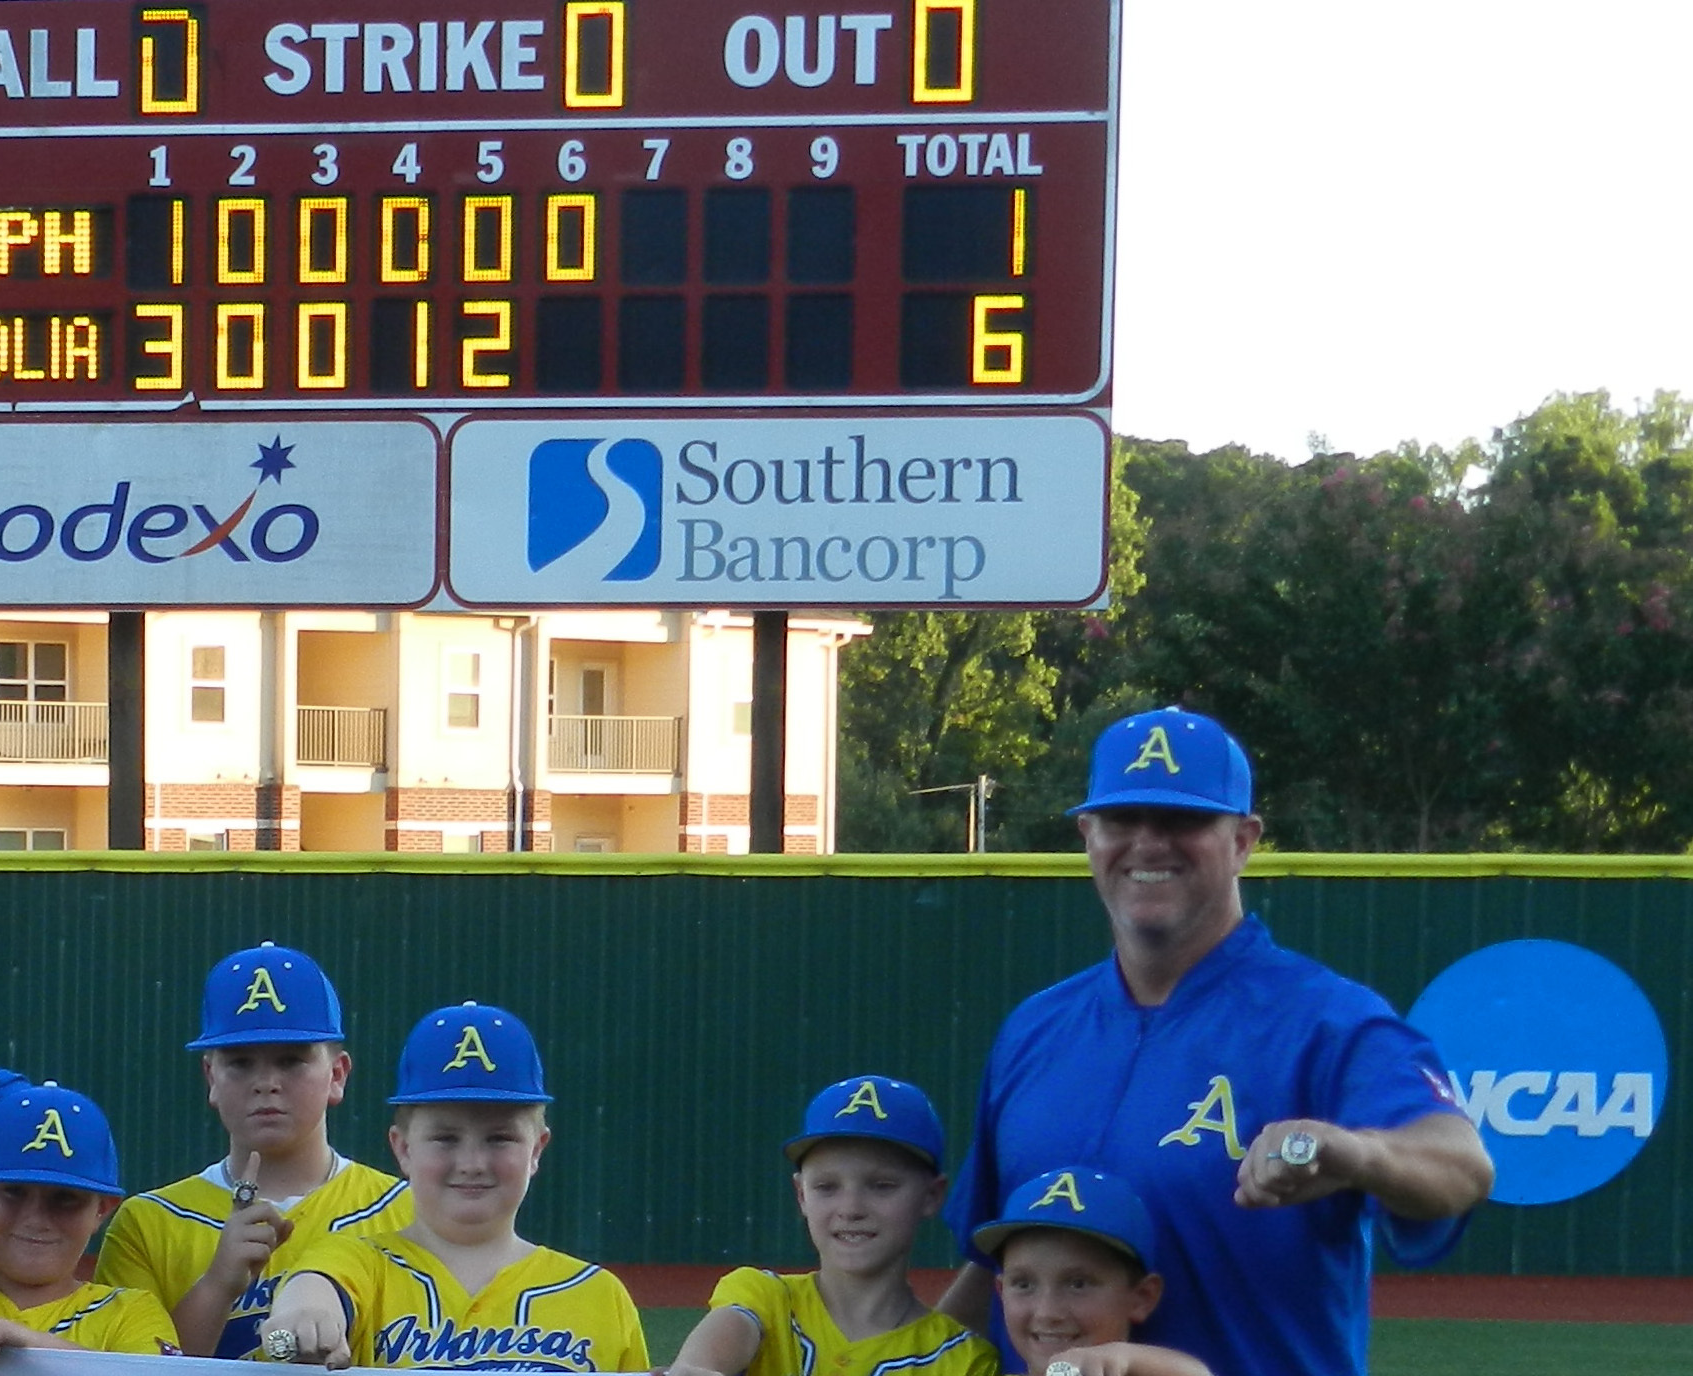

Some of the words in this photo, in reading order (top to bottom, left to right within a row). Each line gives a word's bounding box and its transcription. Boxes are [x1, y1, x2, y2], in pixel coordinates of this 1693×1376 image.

[263, 20, 544, 96] STRIKE
[565, 1, 624, 108] 0
[724, 14, 892, 88] OUT
[912, 0, 974, 103] 0
[148, 145, 171, 187] 1
[228, 144, 256, 186] 2
[311, 143, 340, 186] 3
[393, 142, 422, 183] 4
[476, 141, 504, 182] 5
[557, 140, 587, 182] 6
[642, 139, 670, 180] 7
[724, 138, 754, 180] 8
[809, 136, 840, 179] 9
[896, 133, 1043, 177] TOTAL
[172, 200, 184, 285] 1
[217, 198, 265, 284] 0
[299, 198, 347, 284] 0
[381, 198, 430, 283] 0
[463, 195, 513, 282] 0
[546, 193, 596, 281] 0
[1012, 188, 1025, 276] 1
[135, 304, 183, 390] 3
[216, 303, 265, 389] 0
[298, 302, 346, 389] 0
[415, 302, 428, 389] 1
[462, 300, 511, 388] 2
[972, 294, 1025, 384] 6
[675, 434, 1024, 505] Southern
[676, 517, 986, 600] Bancorp
[1124, 726, 1180, 774] A
[237, 967, 286, 1015] A
[443, 1025, 496, 1073] A
[22, 1109, 73, 1158] A
[834, 1081, 888, 1120] A
[1158, 1074, 1247, 1160] A
[1028, 1173, 1085, 1211] A
